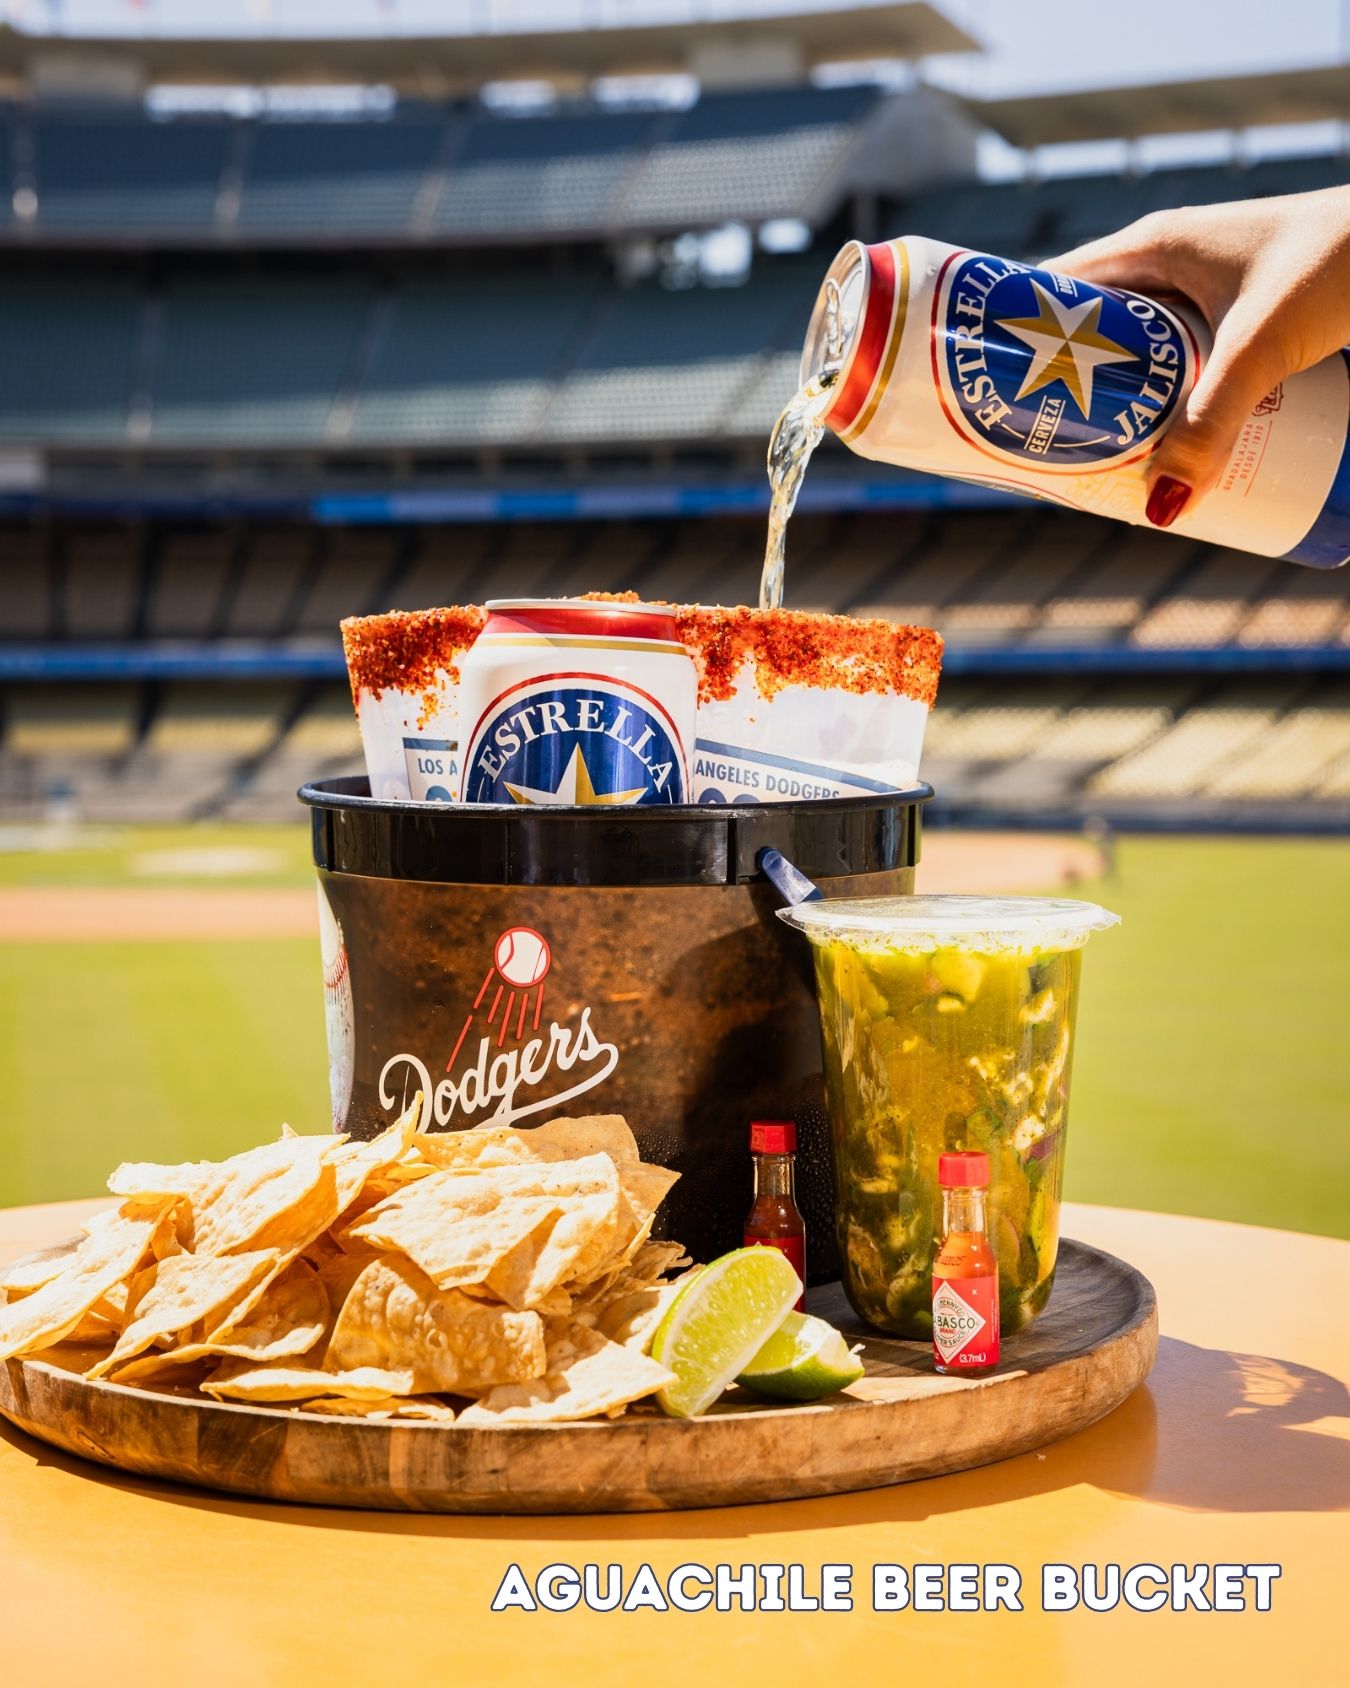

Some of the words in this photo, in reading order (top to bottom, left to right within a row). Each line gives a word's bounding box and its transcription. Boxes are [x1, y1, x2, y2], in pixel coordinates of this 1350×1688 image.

[953, 260, 1031, 431] ESTRELLA
[1113, 300, 1179, 445] JALISCO
[1029, 398, 1062, 454] CERVEZA
[1223, 423, 1253, 491] GUADALAJARA
[1239, 450, 1257, 480] DESDE
[418, 757, 444, 776] LOS
[477, 699, 674, 794] ESTRELLA
[695, 759, 760, 788] ANGELES
[378, 1006, 619, 1133] Dodgers
[934, 1315, 976, 1329] BASCO
